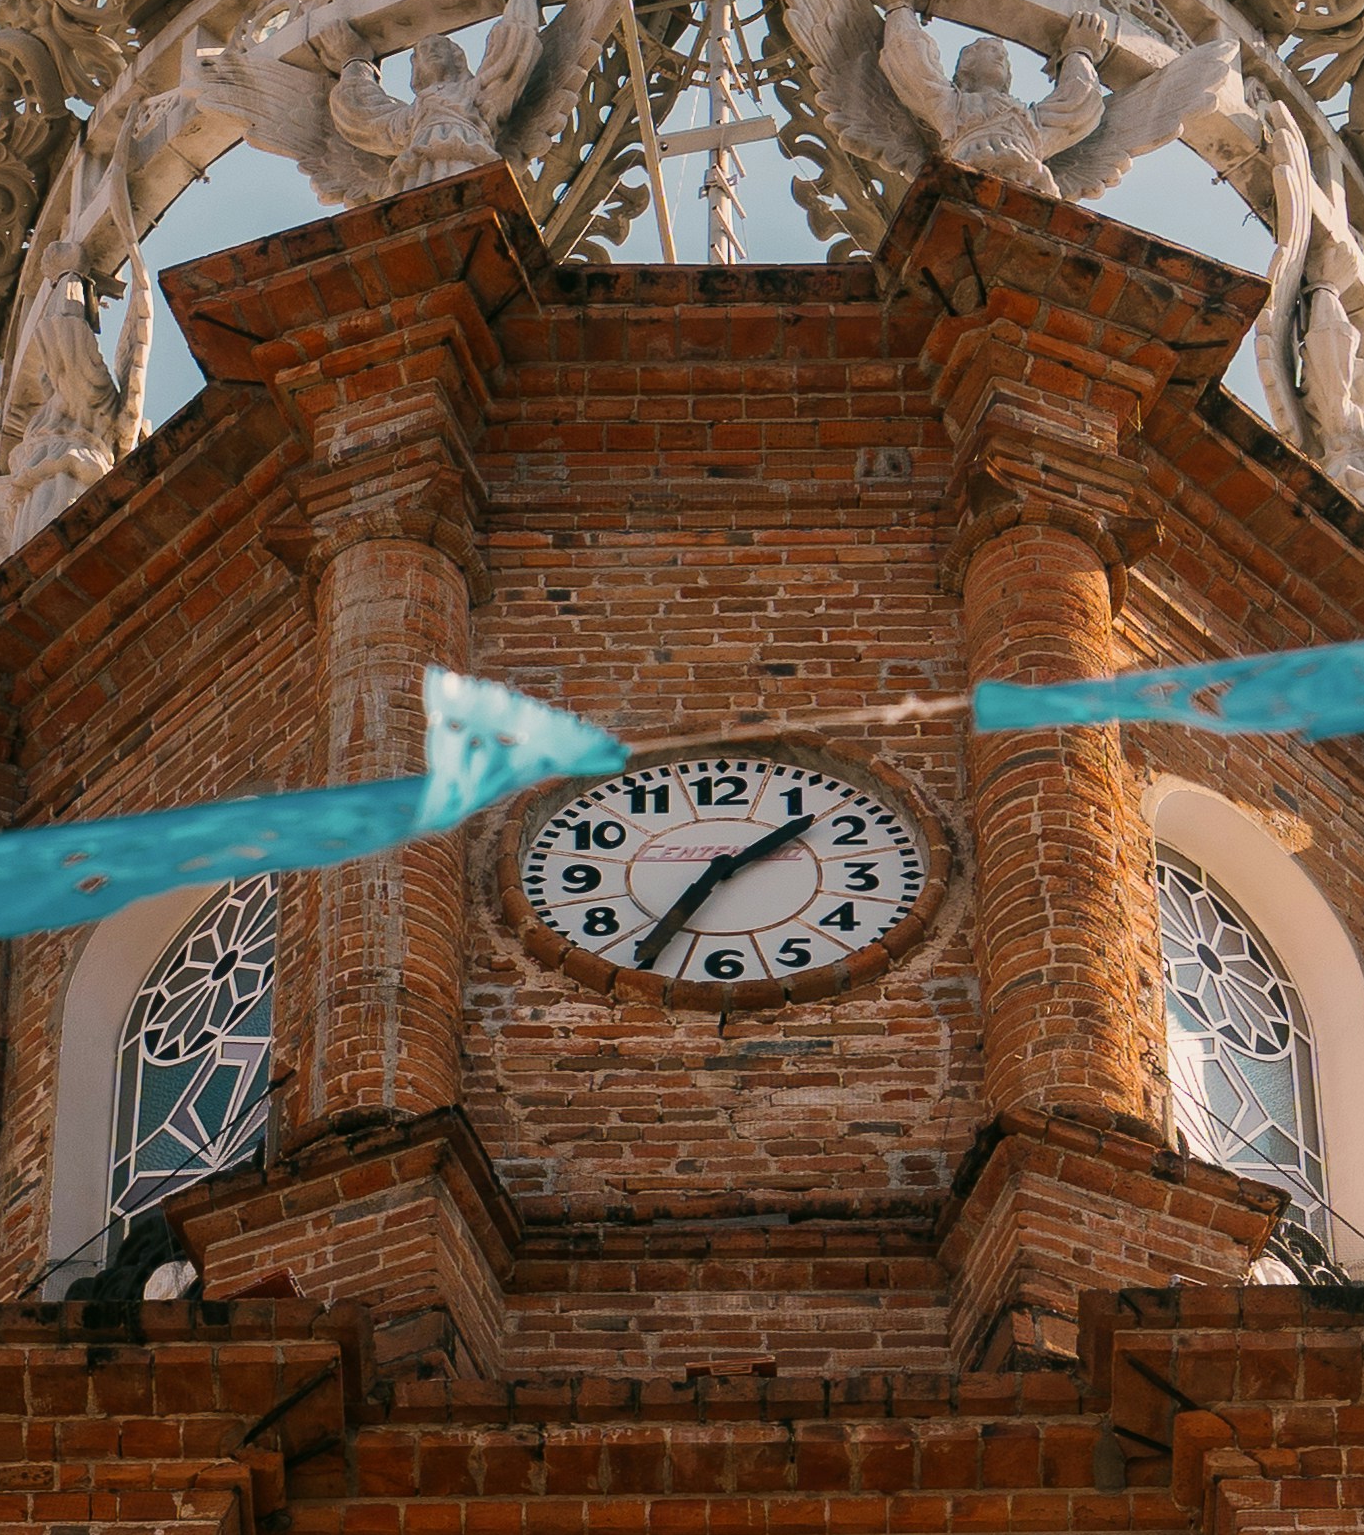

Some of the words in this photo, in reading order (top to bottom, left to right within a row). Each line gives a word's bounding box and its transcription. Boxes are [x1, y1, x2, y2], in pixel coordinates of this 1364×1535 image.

[623, 783, 670, 815] 11
[688, 776, 749, 806] 12
[779, 786, 803, 816] 1
[569, 820, 627, 851] 10
[832, 815, 868, 846] 2
[561, 863, 602, 894] 9
[843, 862, 879, 892] 3
[582, 906, 620, 937] 8
[819, 901, 861, 932] 4
[704, 948, 744, 980] 6
[775, 937, 812, 967] 5
